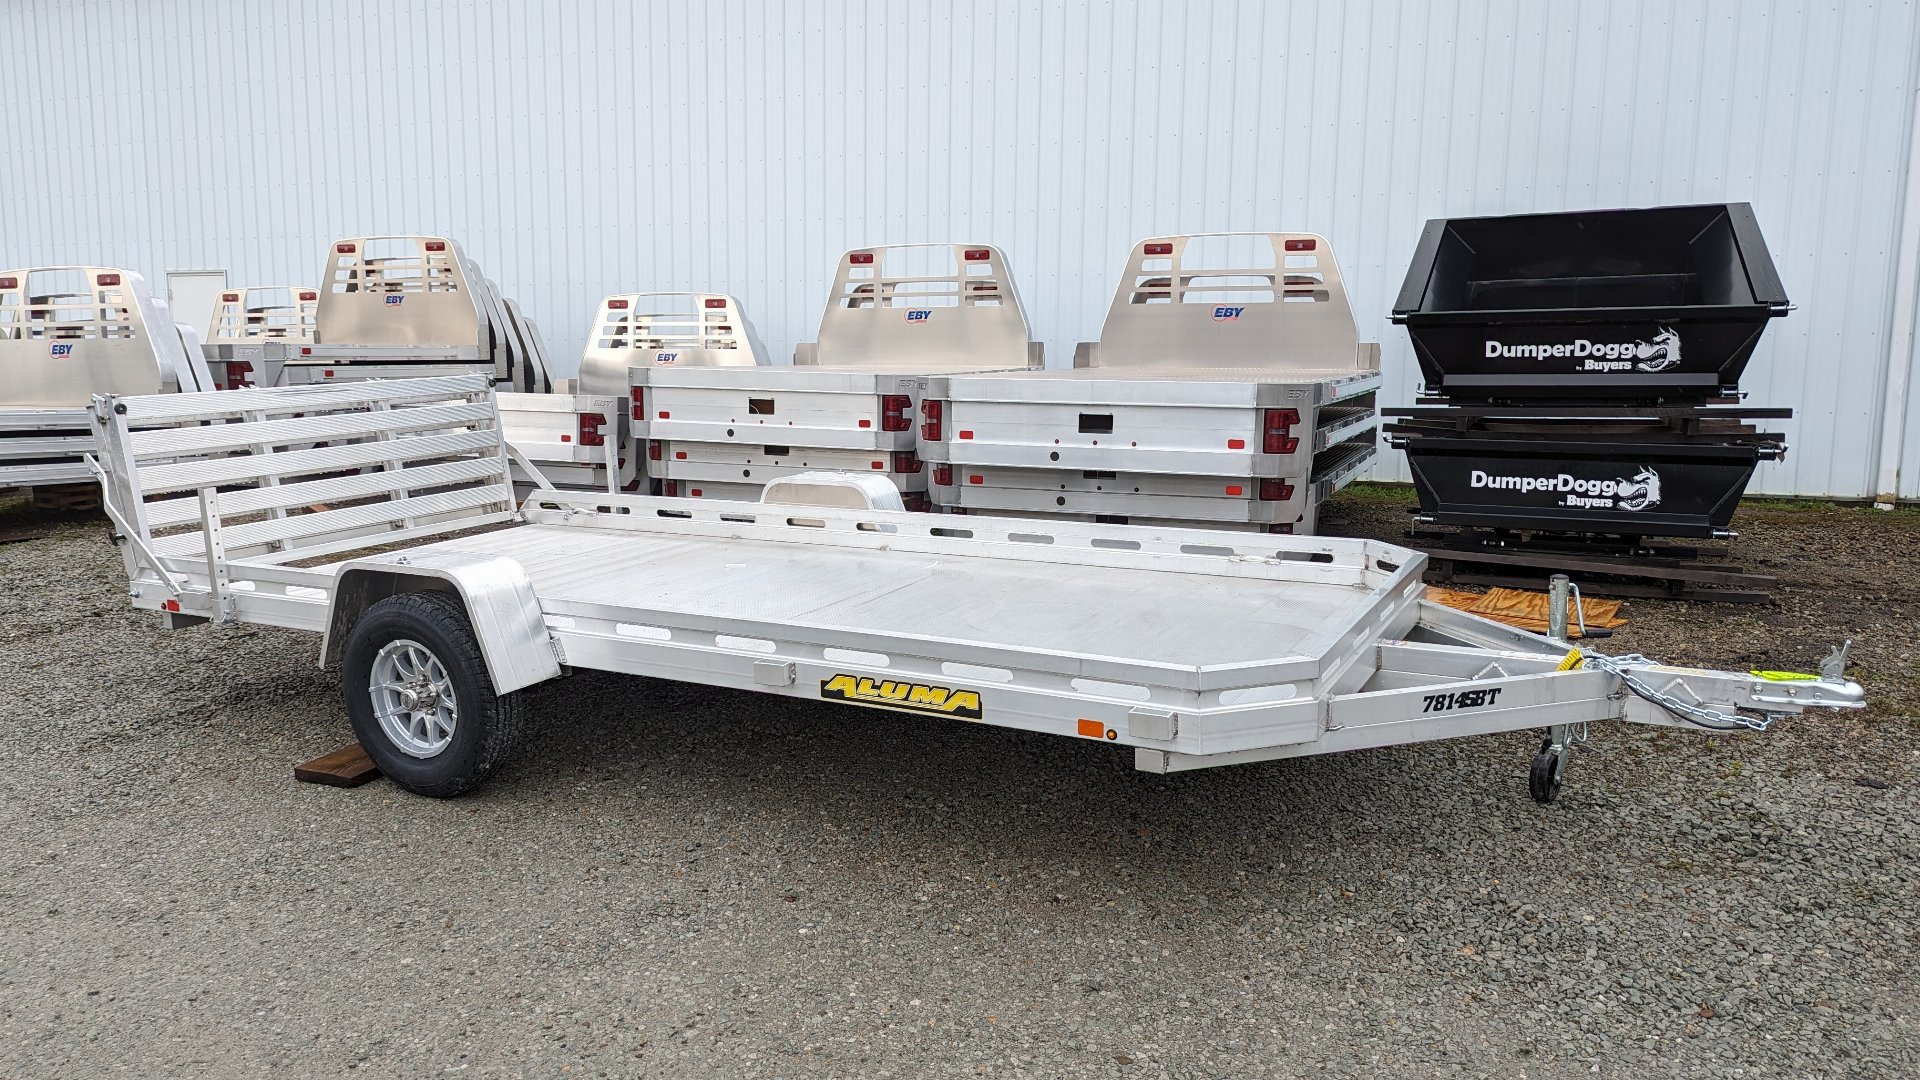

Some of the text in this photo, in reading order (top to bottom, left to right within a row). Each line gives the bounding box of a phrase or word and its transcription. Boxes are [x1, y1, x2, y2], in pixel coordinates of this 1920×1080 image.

[386, 295, 404, 303] EBY
[907, 310, 932, 320] EBY
[1213, 306, 1246, 318] EBY
[51, 344, 73, 354] EBY
[1485, 339, 1636, 361] DumperDogg
[656, 353, 678, 362] EBY
[1584, 359, 1632, 373] Buyers
[1470, 470, 1618, 497] DumperDogg
[1566, 494, 1614, 509] Buyers
[822, 674, 982, 713] ALUMA
